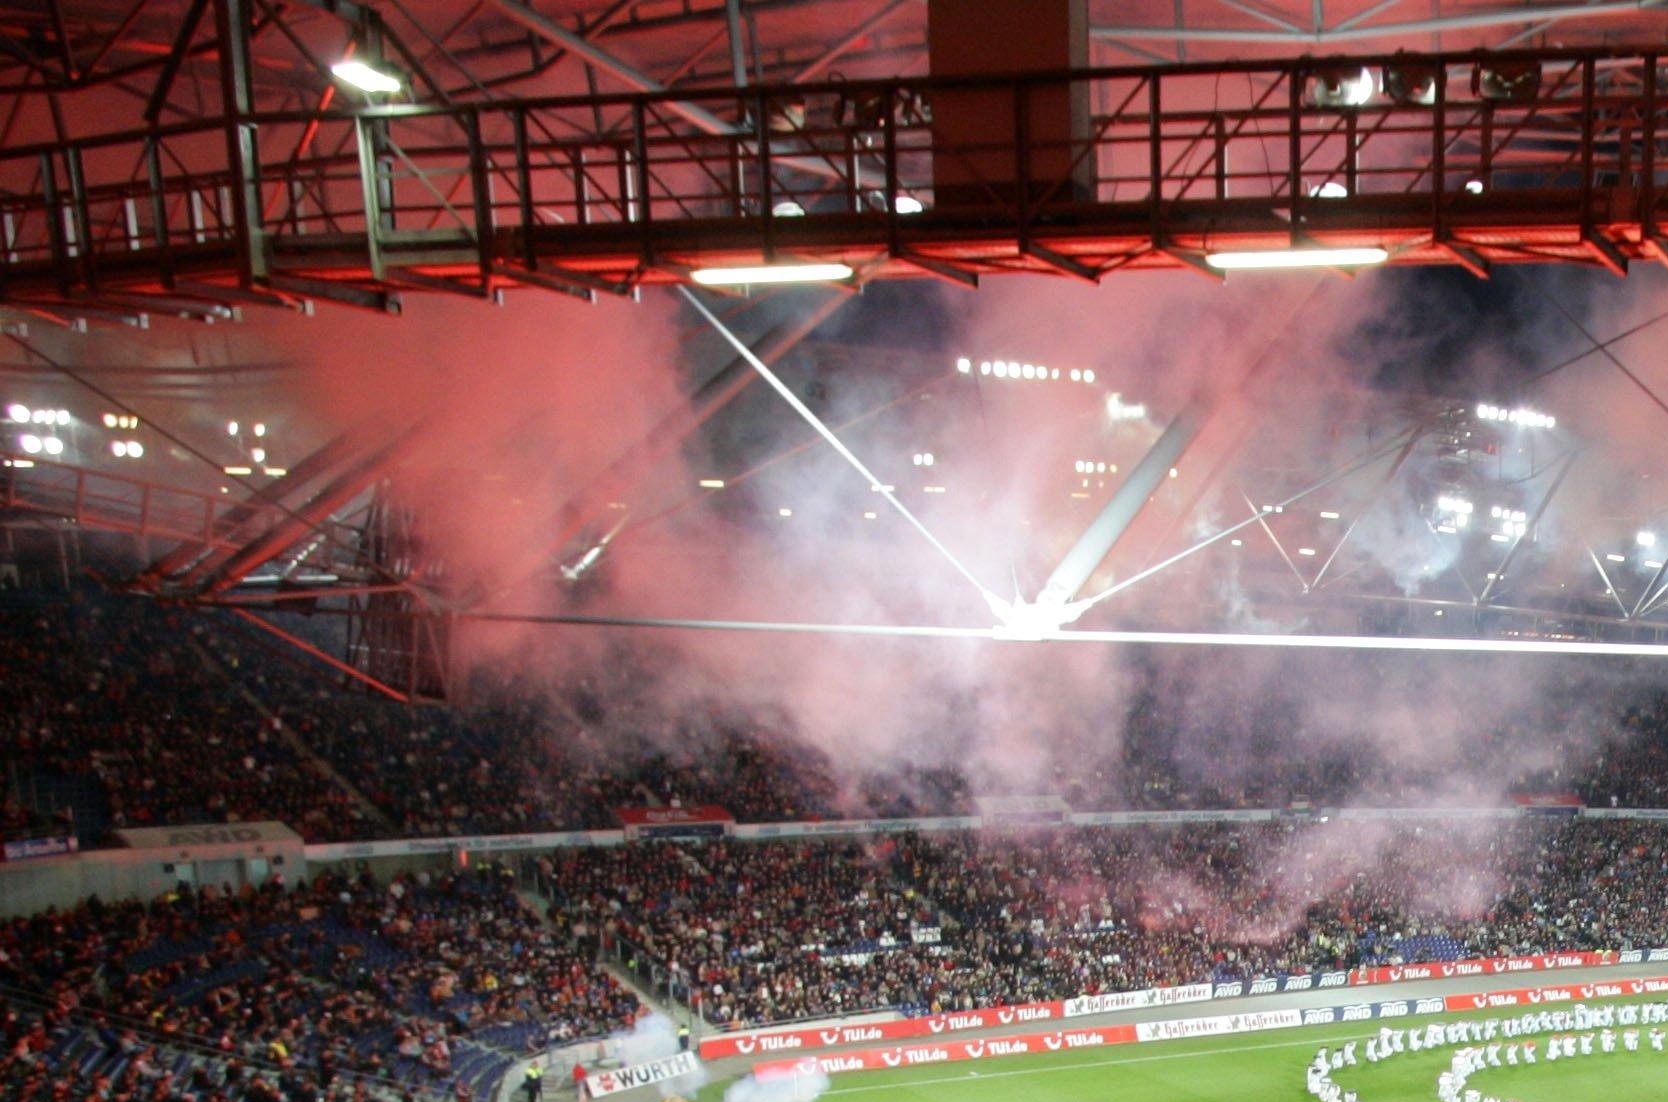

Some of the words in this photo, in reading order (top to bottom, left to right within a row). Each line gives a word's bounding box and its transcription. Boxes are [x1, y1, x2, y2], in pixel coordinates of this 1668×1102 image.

[1404, 968, 1431, 979] TUI.de
[1456, 963, 1483, 974] TUI.de
[1508, 959, 1534, 971] TUI.de
[1557, 956, 1582, 966] TUI.de
[1214, 984, 1243, 998] AWD
[1249, 980, 1277, 994] AWD
[1284, 977, 1312, 991] AWD
[1319, 973, 1346, 987] AWD
[1490, 994, 1517, 1005] TUI.de
[1543, 989, 1571, 1001] TUI.de
[1597, 985, 1622, 996] TUI.de
[1303, 1009, 1335, 1025] AWD
[1342, 1006, 1372, 1021] AWD
[1379, 1002, 1408, 1017] AWD
[1415, 998, 1444, 1014] AWD
[760, 1036, 801, 1050] TUI.de
[843, 1028, 883, 1041] TUI.de
[949, 1016, 984, 1030] TUI.de
[1017, 1006, 1051, 1021] TUI.de
[820, 1056, 864, 1073] TUI.de
[905, 1048, 948, 1063] TUI.de
[988, 1040, 1028, 1055] TUI.de
[1065, 1033, 1104, 1047] TUI.de
[615, 1053, 688, 1088] WÜRTH
